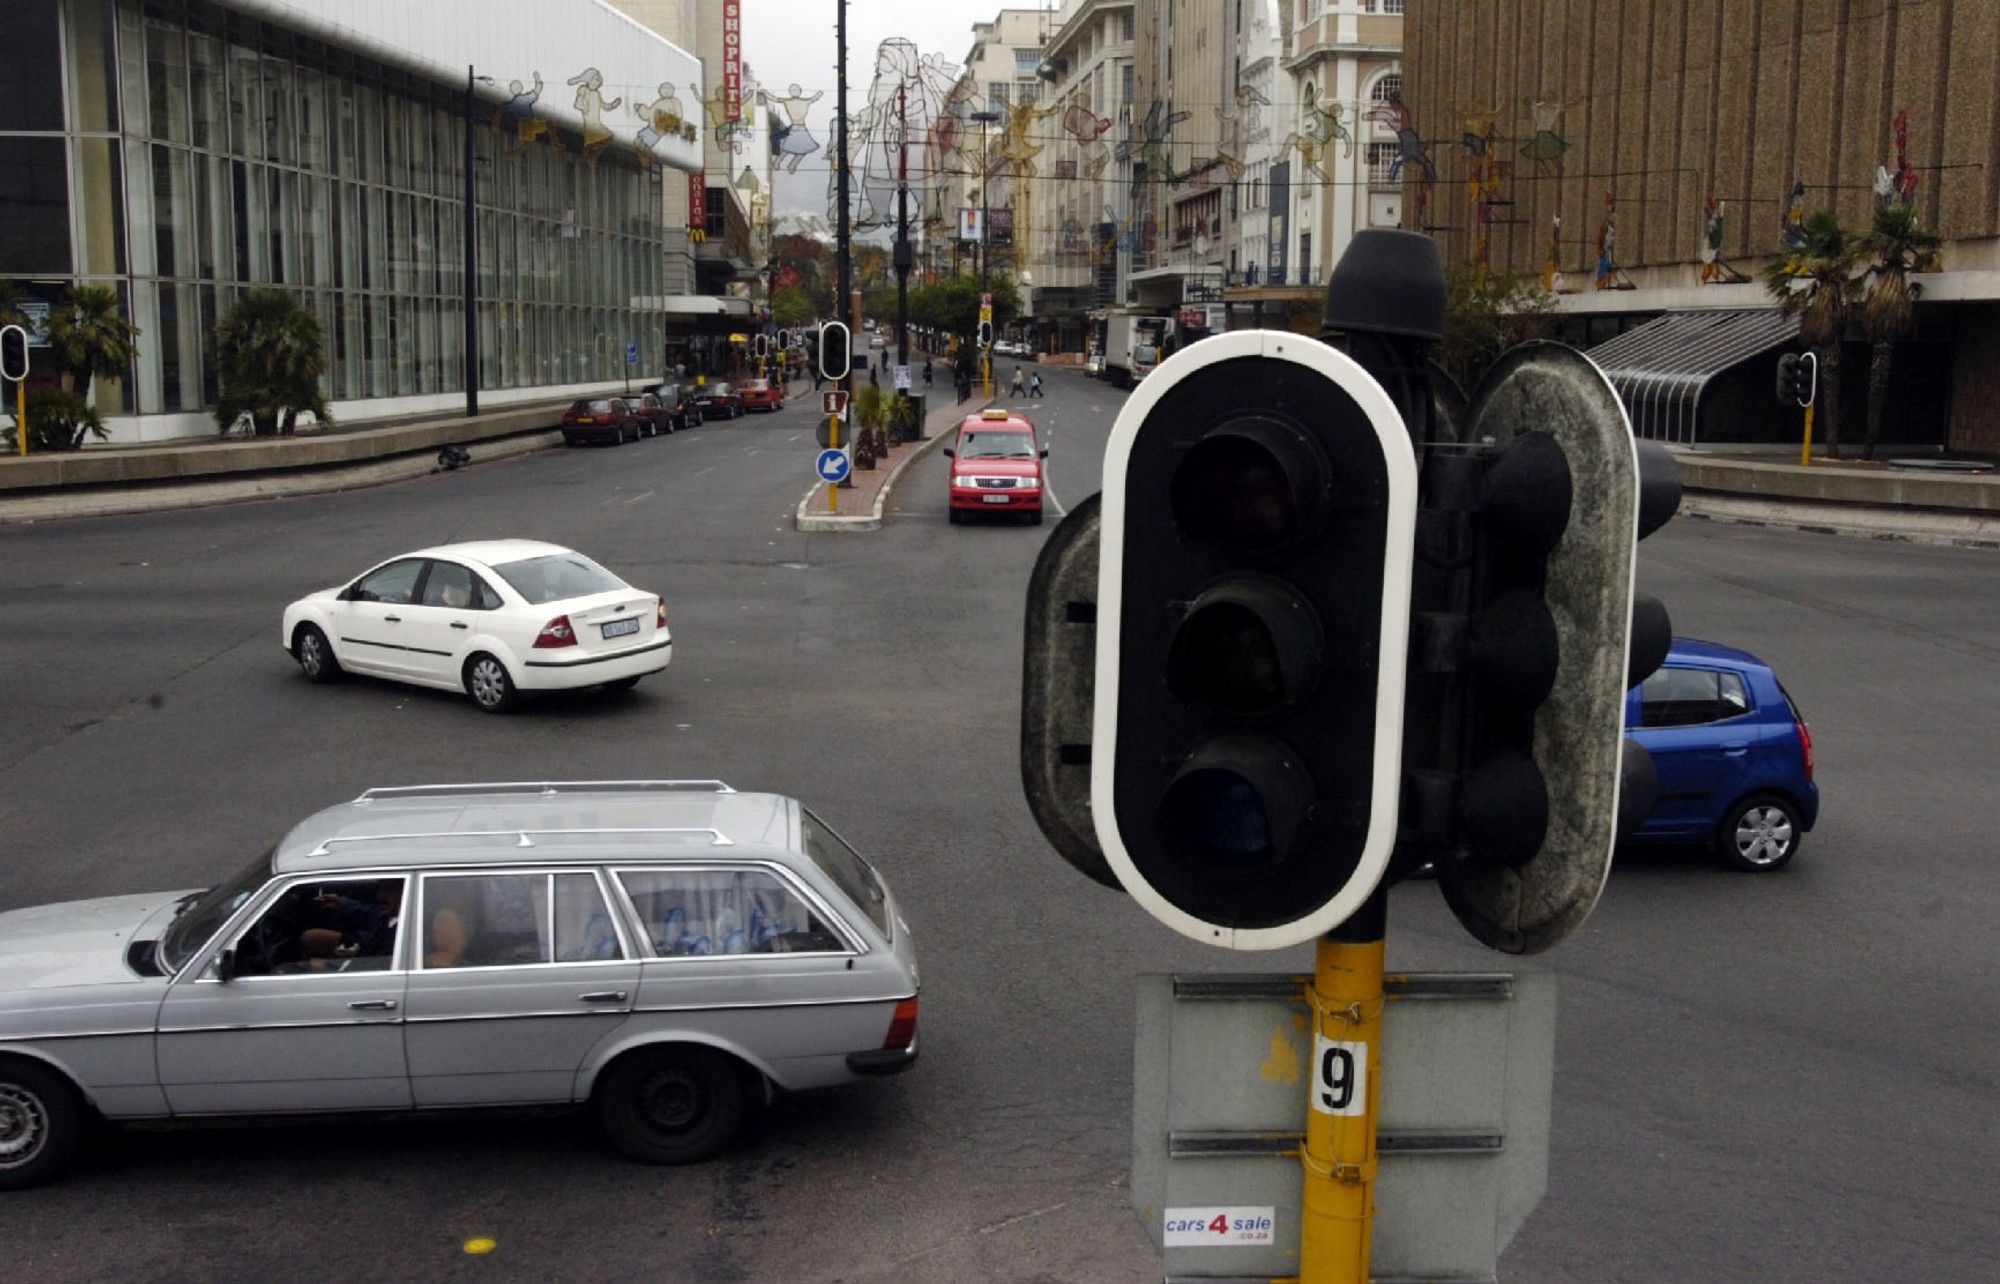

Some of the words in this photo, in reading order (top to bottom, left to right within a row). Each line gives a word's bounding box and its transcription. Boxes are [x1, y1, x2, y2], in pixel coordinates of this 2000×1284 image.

[725, 5, 739, 116] SHOPRITE
[1321, 1047, 1355, 1109] 9
[1166, 1219, 1205, 1232] cars
[1208, 1214, 1229, 1235] 4
[1233, 1216, 1271, 1230] sale
